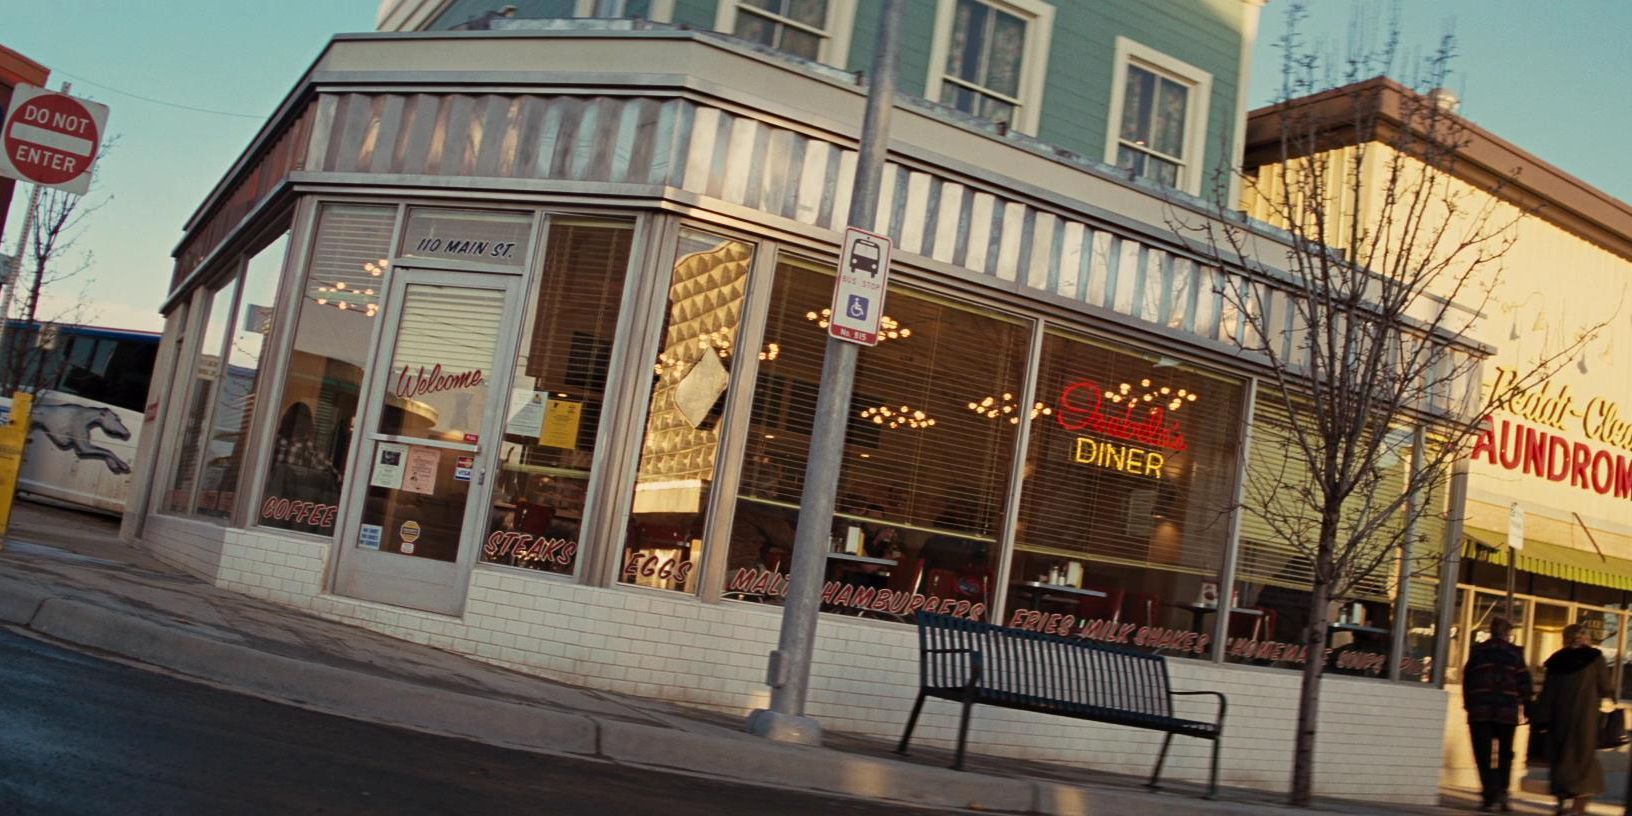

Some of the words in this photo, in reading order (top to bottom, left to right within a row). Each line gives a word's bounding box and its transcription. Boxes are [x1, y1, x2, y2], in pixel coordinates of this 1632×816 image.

[24, 104, 48, 124] DO
[52, 112, 90, 134] NOT
[15, 145, 77, 173] ENTER
[417, 238, 440, 252] 110
[444, 240, 488, 256] MAIN
[491, 243, 515, 258] ST.
[842, 275, 856, 285] BUS
[861, 280, 880, 289] STOP
[396, 363, 483, 398] Welcome
[1076, 437, 1164, 479] DINER
[262, 496, 338, 527] COFFEE
[484, 531, 578, 565] STEAKS
[624, 553, 693, 583] EGGS
[820, 580, 986, 622] HAMBURGERS
[1009, 608, 1075, 637] FRIES
[1081, 619, 1136, 644] MILK
[1134, 626, 1211, 654] SHAKES
[1231, 637, 1333, 666] HOMEMAE
